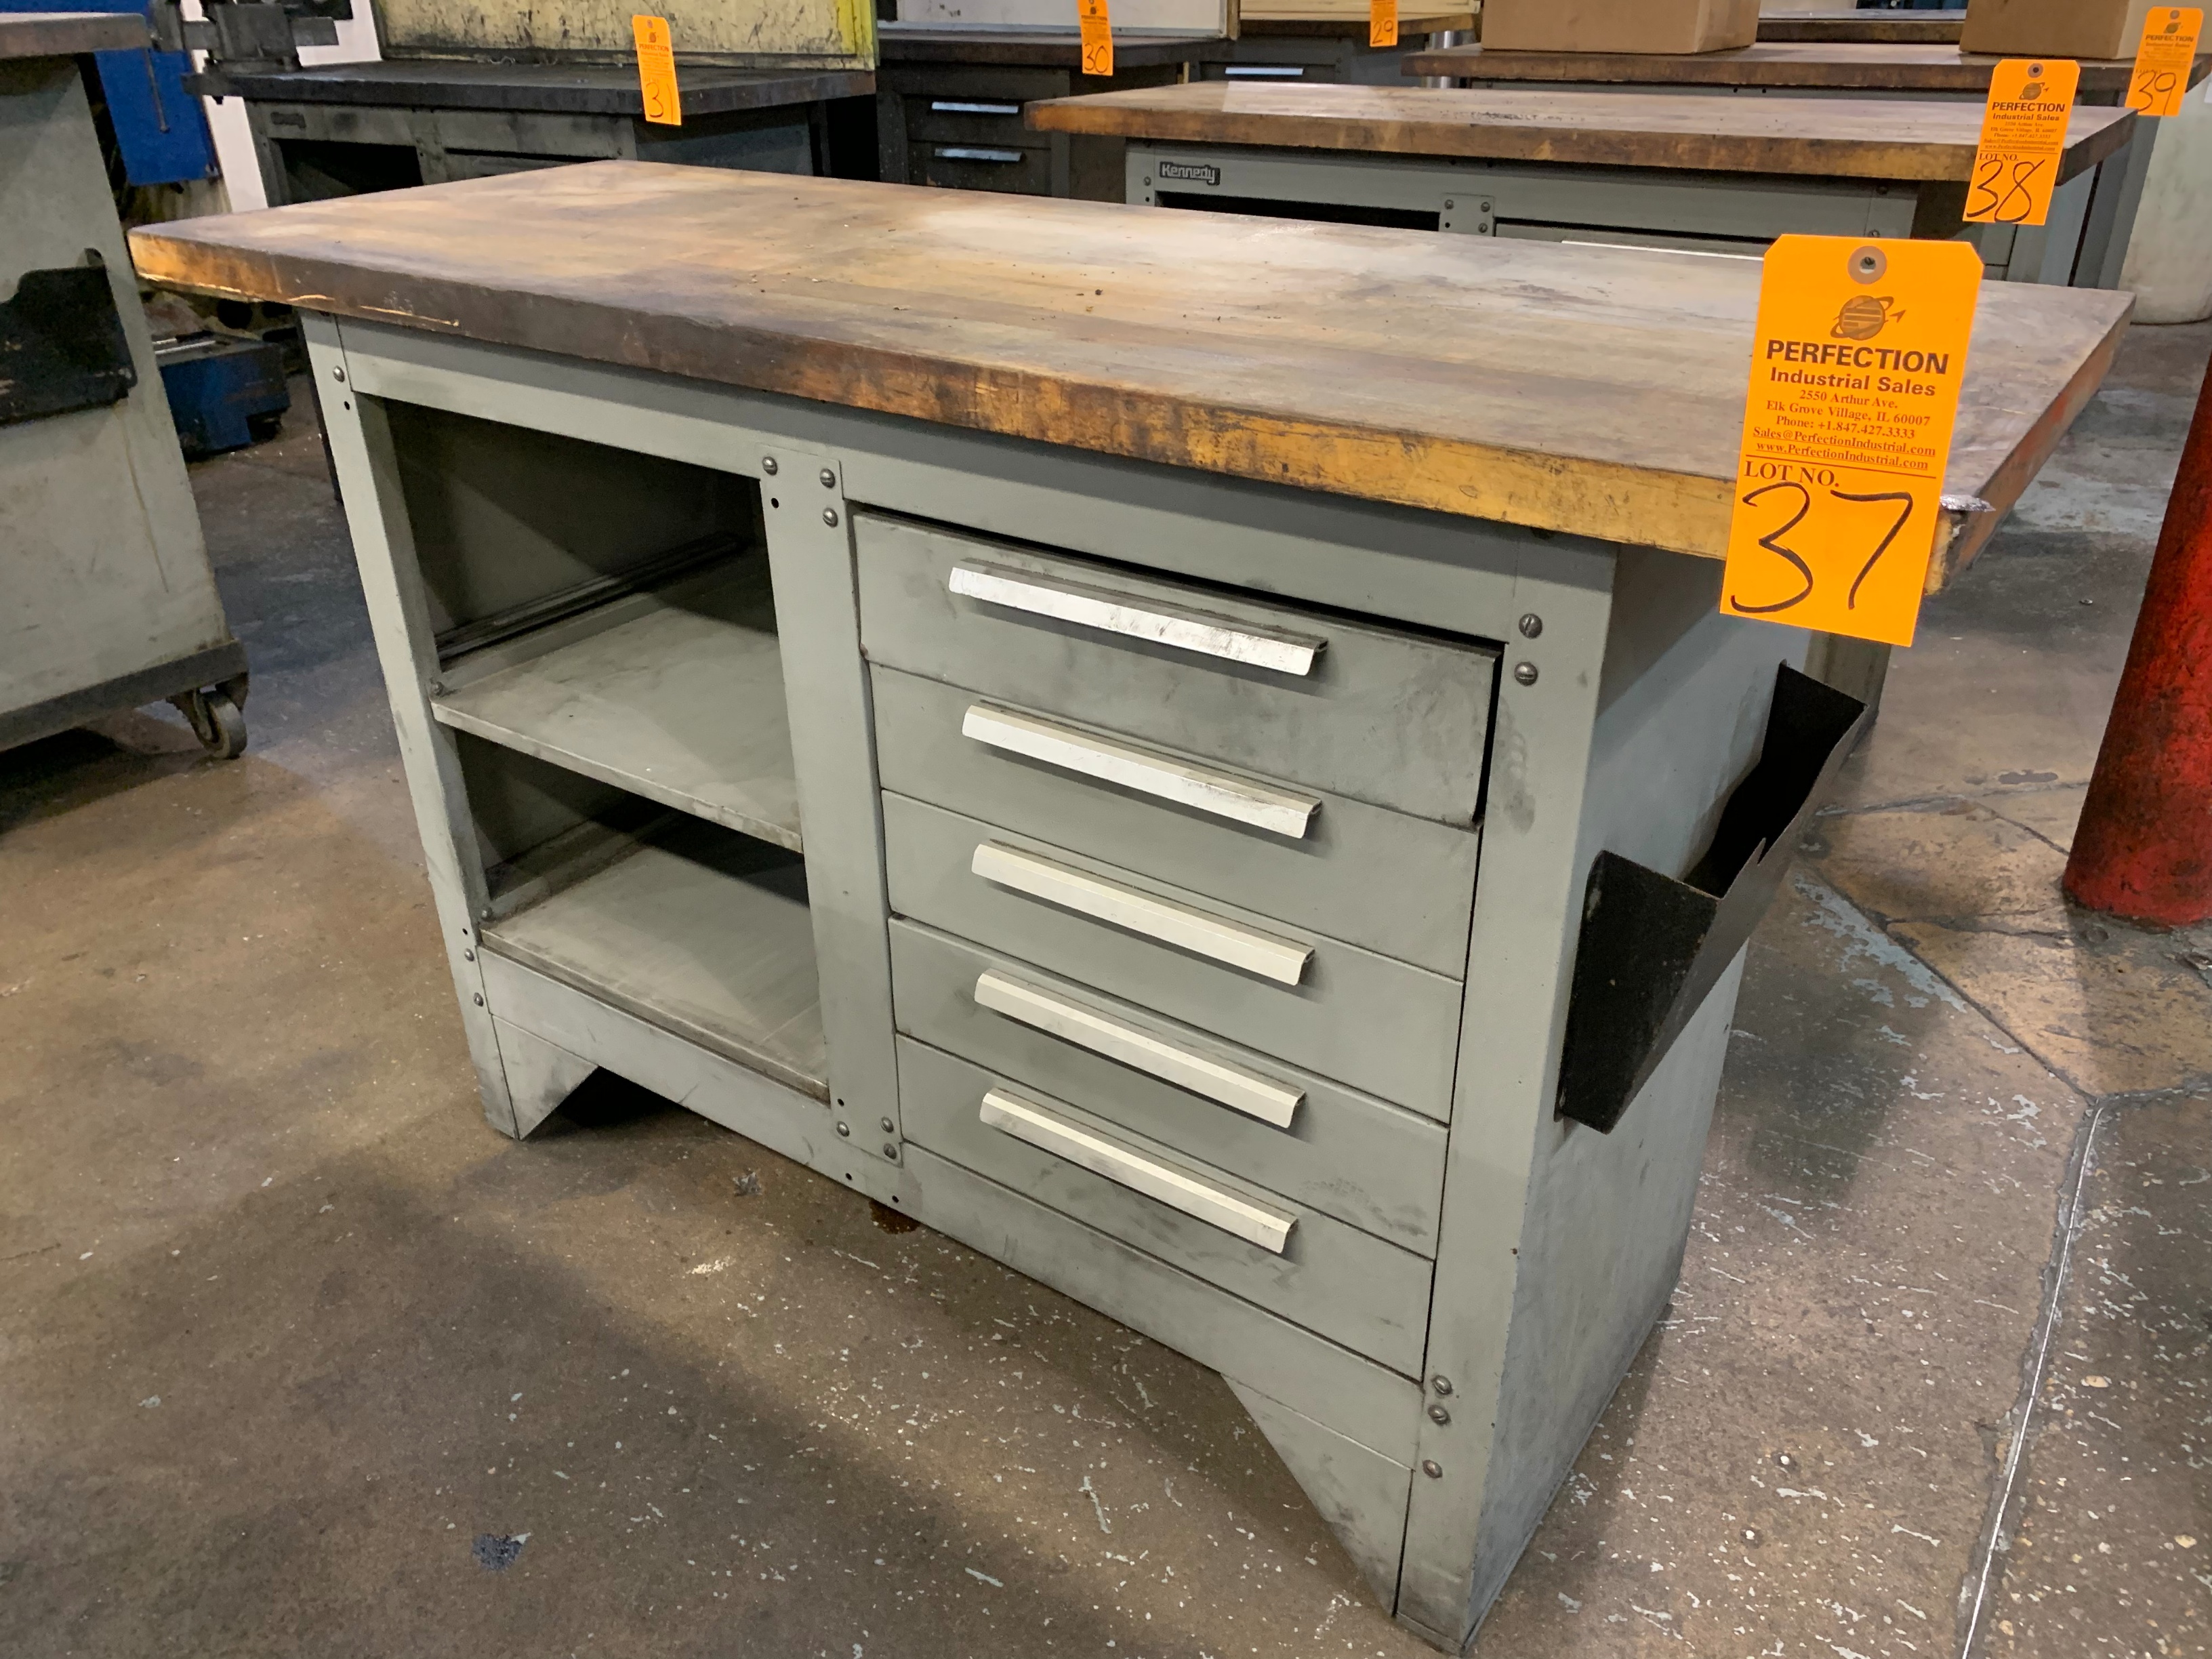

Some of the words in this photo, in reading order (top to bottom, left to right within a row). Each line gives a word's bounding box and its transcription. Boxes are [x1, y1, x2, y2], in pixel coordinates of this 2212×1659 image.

[1372, 20, 1394, 44] 29
[1084, 43, 1109, 73] 30
[646, 82, 673, 123] 31
[1992, 102, 2066, 112] PERFECTION
[2137, 70, 2176, 116] 39
[1979, 152, 1998, 161] LOT
[2001, 153, 2019, 161] NO.
[1161, 163, 1216, 184] Kennedy
[1967, 159, 2045, 223] 38
[1766, 340, 1949, 375] PERFECTION
[1770, 367, 1870, 390] Industrial
[1877, 376, 1936, 396] Sales
[1766, 400, 1786, 411] Elk
[1789, 403, 1823, 415] Grove
[1828, 406, 1872, 422] Village,
[1877, 411, 1889, 422] IL
[1893, 413, 1931, 426] 60007
[1799, 389, 1827, 401] 2550
[1830, 392, 1870, 406] Arthur
[1872, 396, 1898, 409] Ave.
[1776, 415, 1814, 428] Phone:
[1818, 420, 1915, 439] +1.847.427.3333
[1753, 427, 1936, 457] Sales@PerfectionIndustrial.com
[1756, 442, 1929, 470] www.PerfectionIndustrial.com
[1744, 461, 1793, 481] LOT
[1799, 466, 1839, 487] NO.
[1730, 481, 1913, 613] 37
